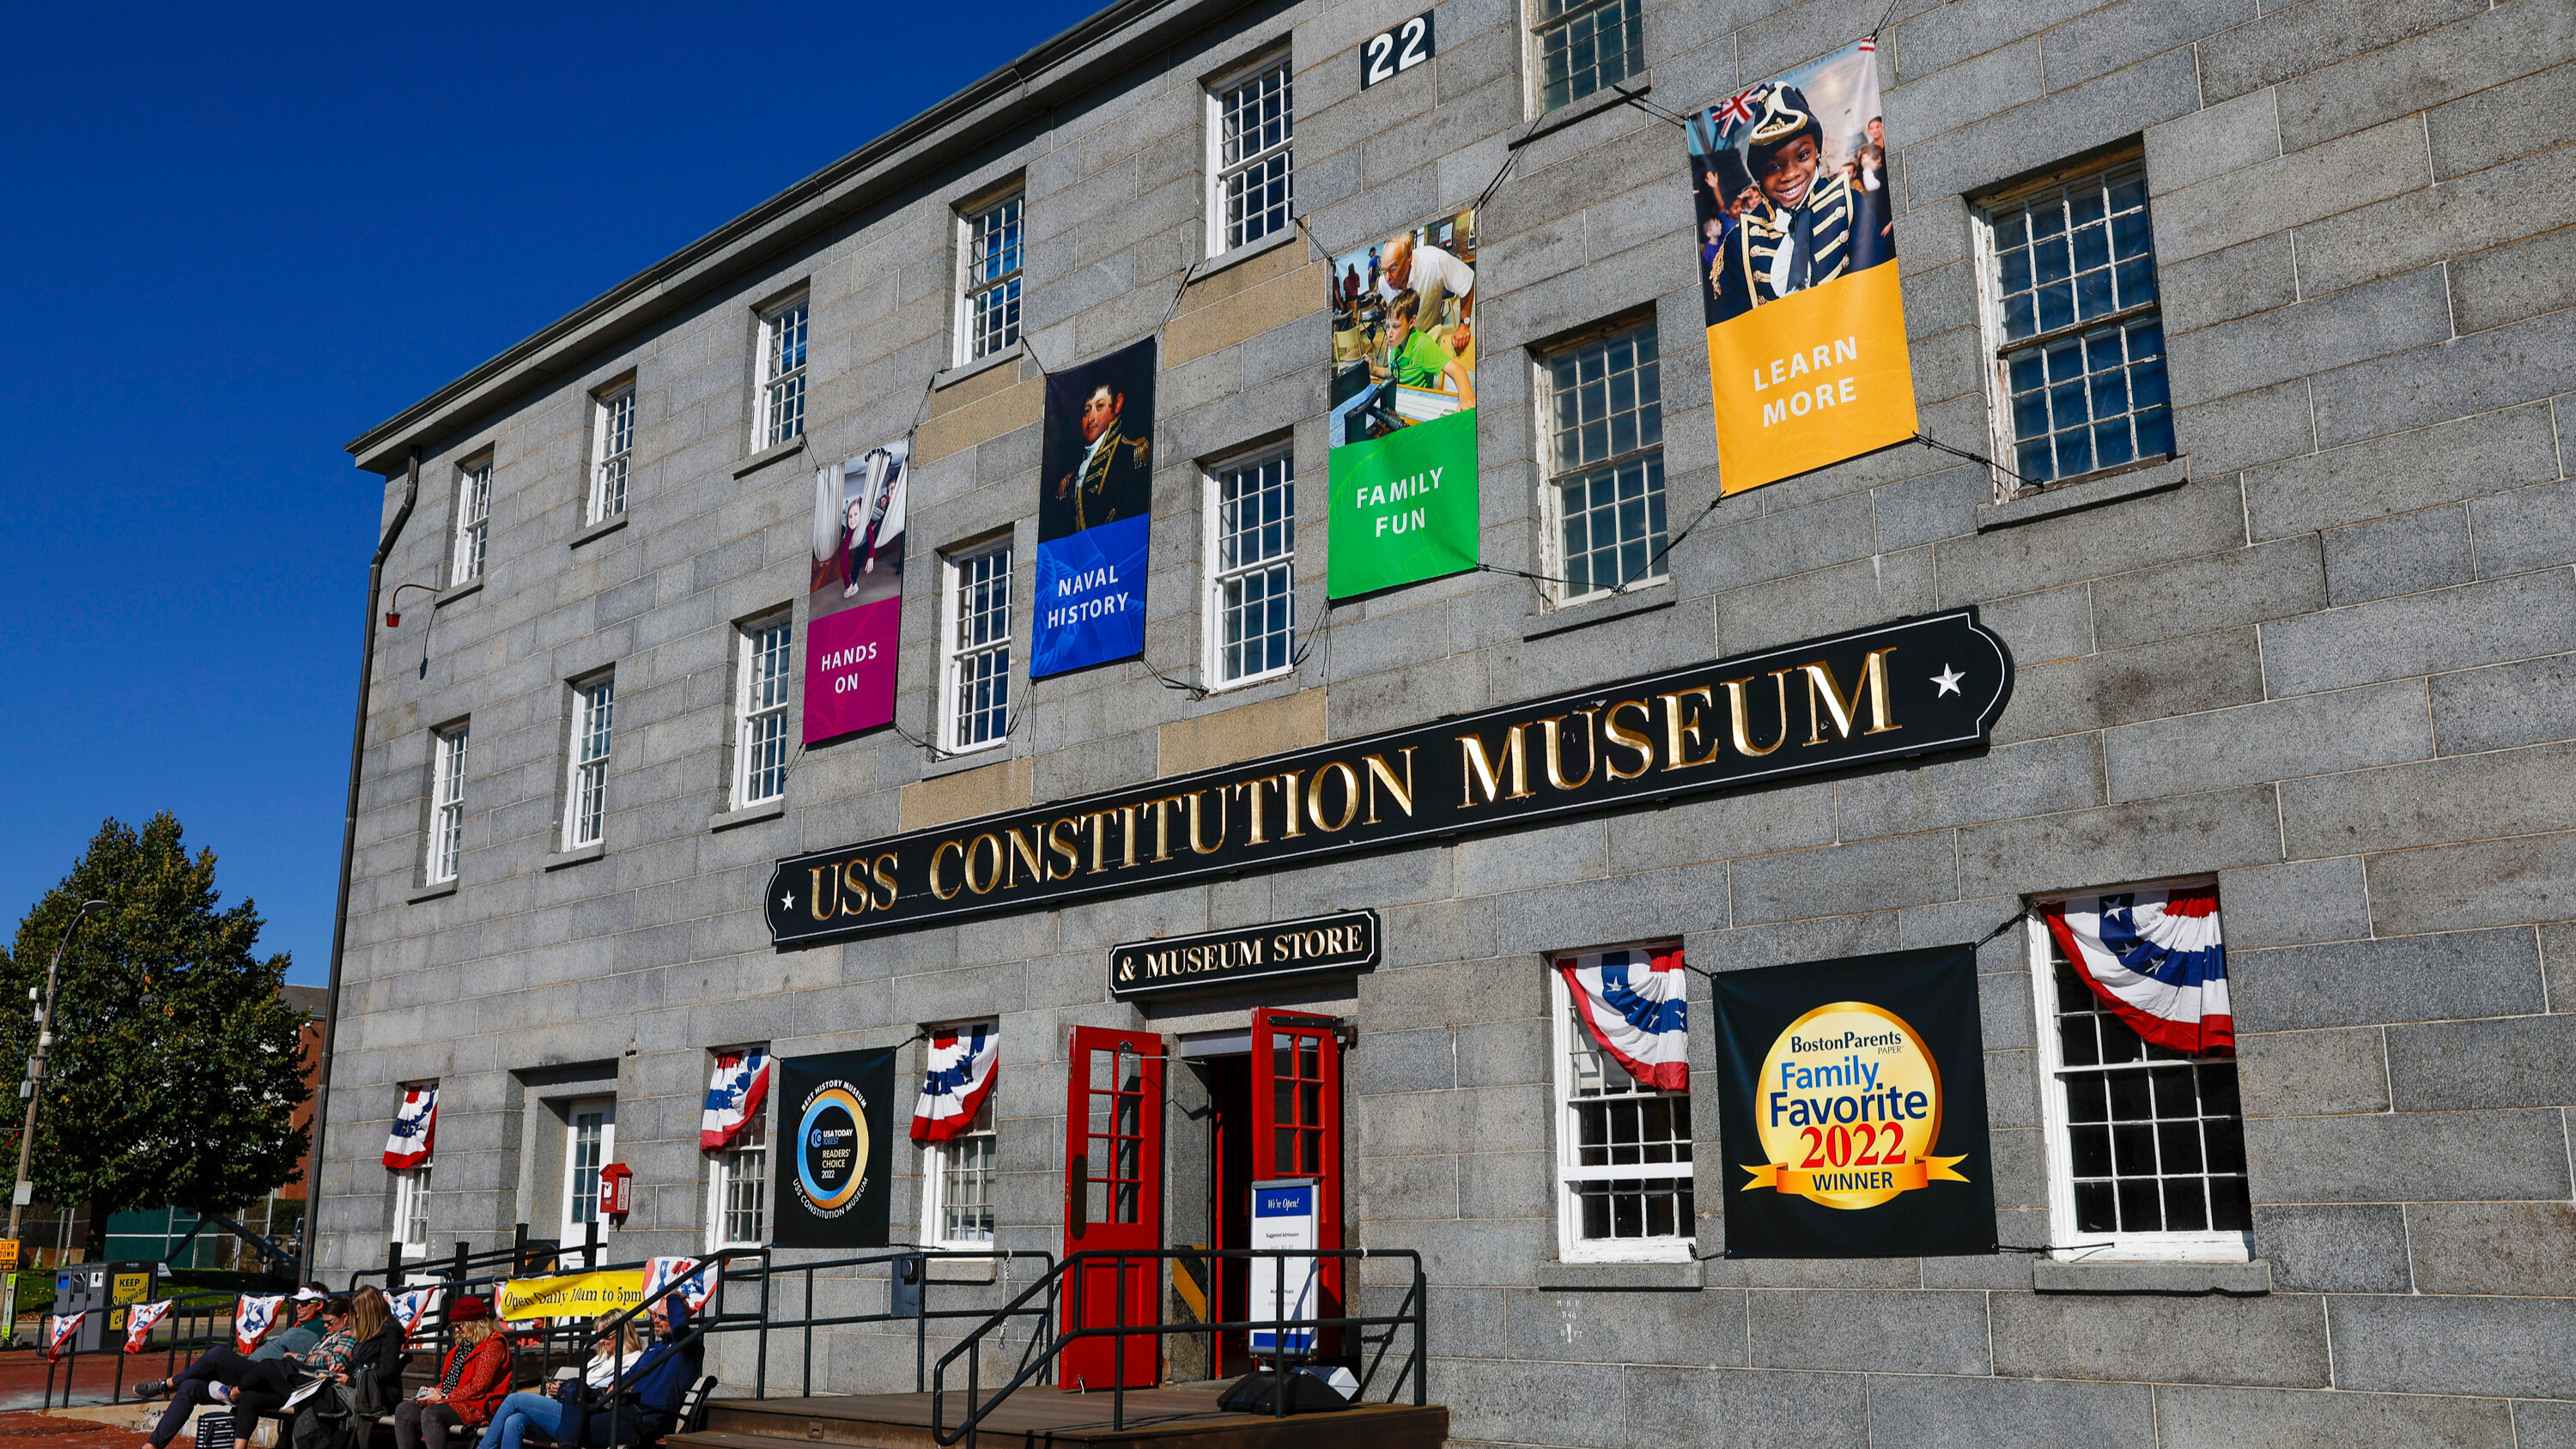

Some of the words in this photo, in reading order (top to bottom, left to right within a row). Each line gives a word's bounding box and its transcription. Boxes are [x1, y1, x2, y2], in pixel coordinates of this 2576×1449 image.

[1367, 17, 1426, 86] 22
[1753, 336, 1857, 392] LEARN
[1763, 377, 1856, 428] MORE
[1357, 467, 1443, 509] FAMILY
[1375, 507, 1425, 538] FUN
[1058, 565, 1119, 597] NAVAL
[1048, 592, 1129, 629] HISTORY
[821, 642, 878, 672] HANDS
[835, 673, 859, 694] ON
[810, 852, 899, 922] USS
[929, 745, 1419, 901] CONSTITUTION
[1455, 646, 1903, 809] MUSEUM
[1119, 955, 1136, 982] &
[1145, 937, 1264, 979] MUSEUM
[1273, 924, 1364, 962] STORE
[1781, 1055, 1879, 1093] Family
[801, 1091, 814, 1112] BEST
[815, 1079, 842, 1095] HISTORY
[843, 1081, 867, 1109] MUSEUM
[1770, 1083, 1928, 1128] Favorite
[822, 1149, 851, 1158] READERS'
[1800, 1121, 1907, 1169] 2022
[821, 1170, 835, 1179] 2022
[822, 1159, 845, 1168] CHOICE
[619, 1179, 627, 1209] FIRE
[1812, 1172, 1894, 1191] WINNER
[793, 1178, 802, 1196] USS
[801, 1195, 845, 1219] CONSTITUTION
[846, 1177, 868, 1212] MUSEUM
[1267, 1199, 1282, 1209] We're
[1282, 1197, 1299, 1211] Open!
[119, 1278, 140, 1287] KEEP
[504, 1291, 535, 1309] Open
[534, 1289, 568, 1307] Daily
[570, 1288, 598, 1303] 10am
[602, 1290, 614, 1302] to
[617, 1287, 642, 1306] 5pm
